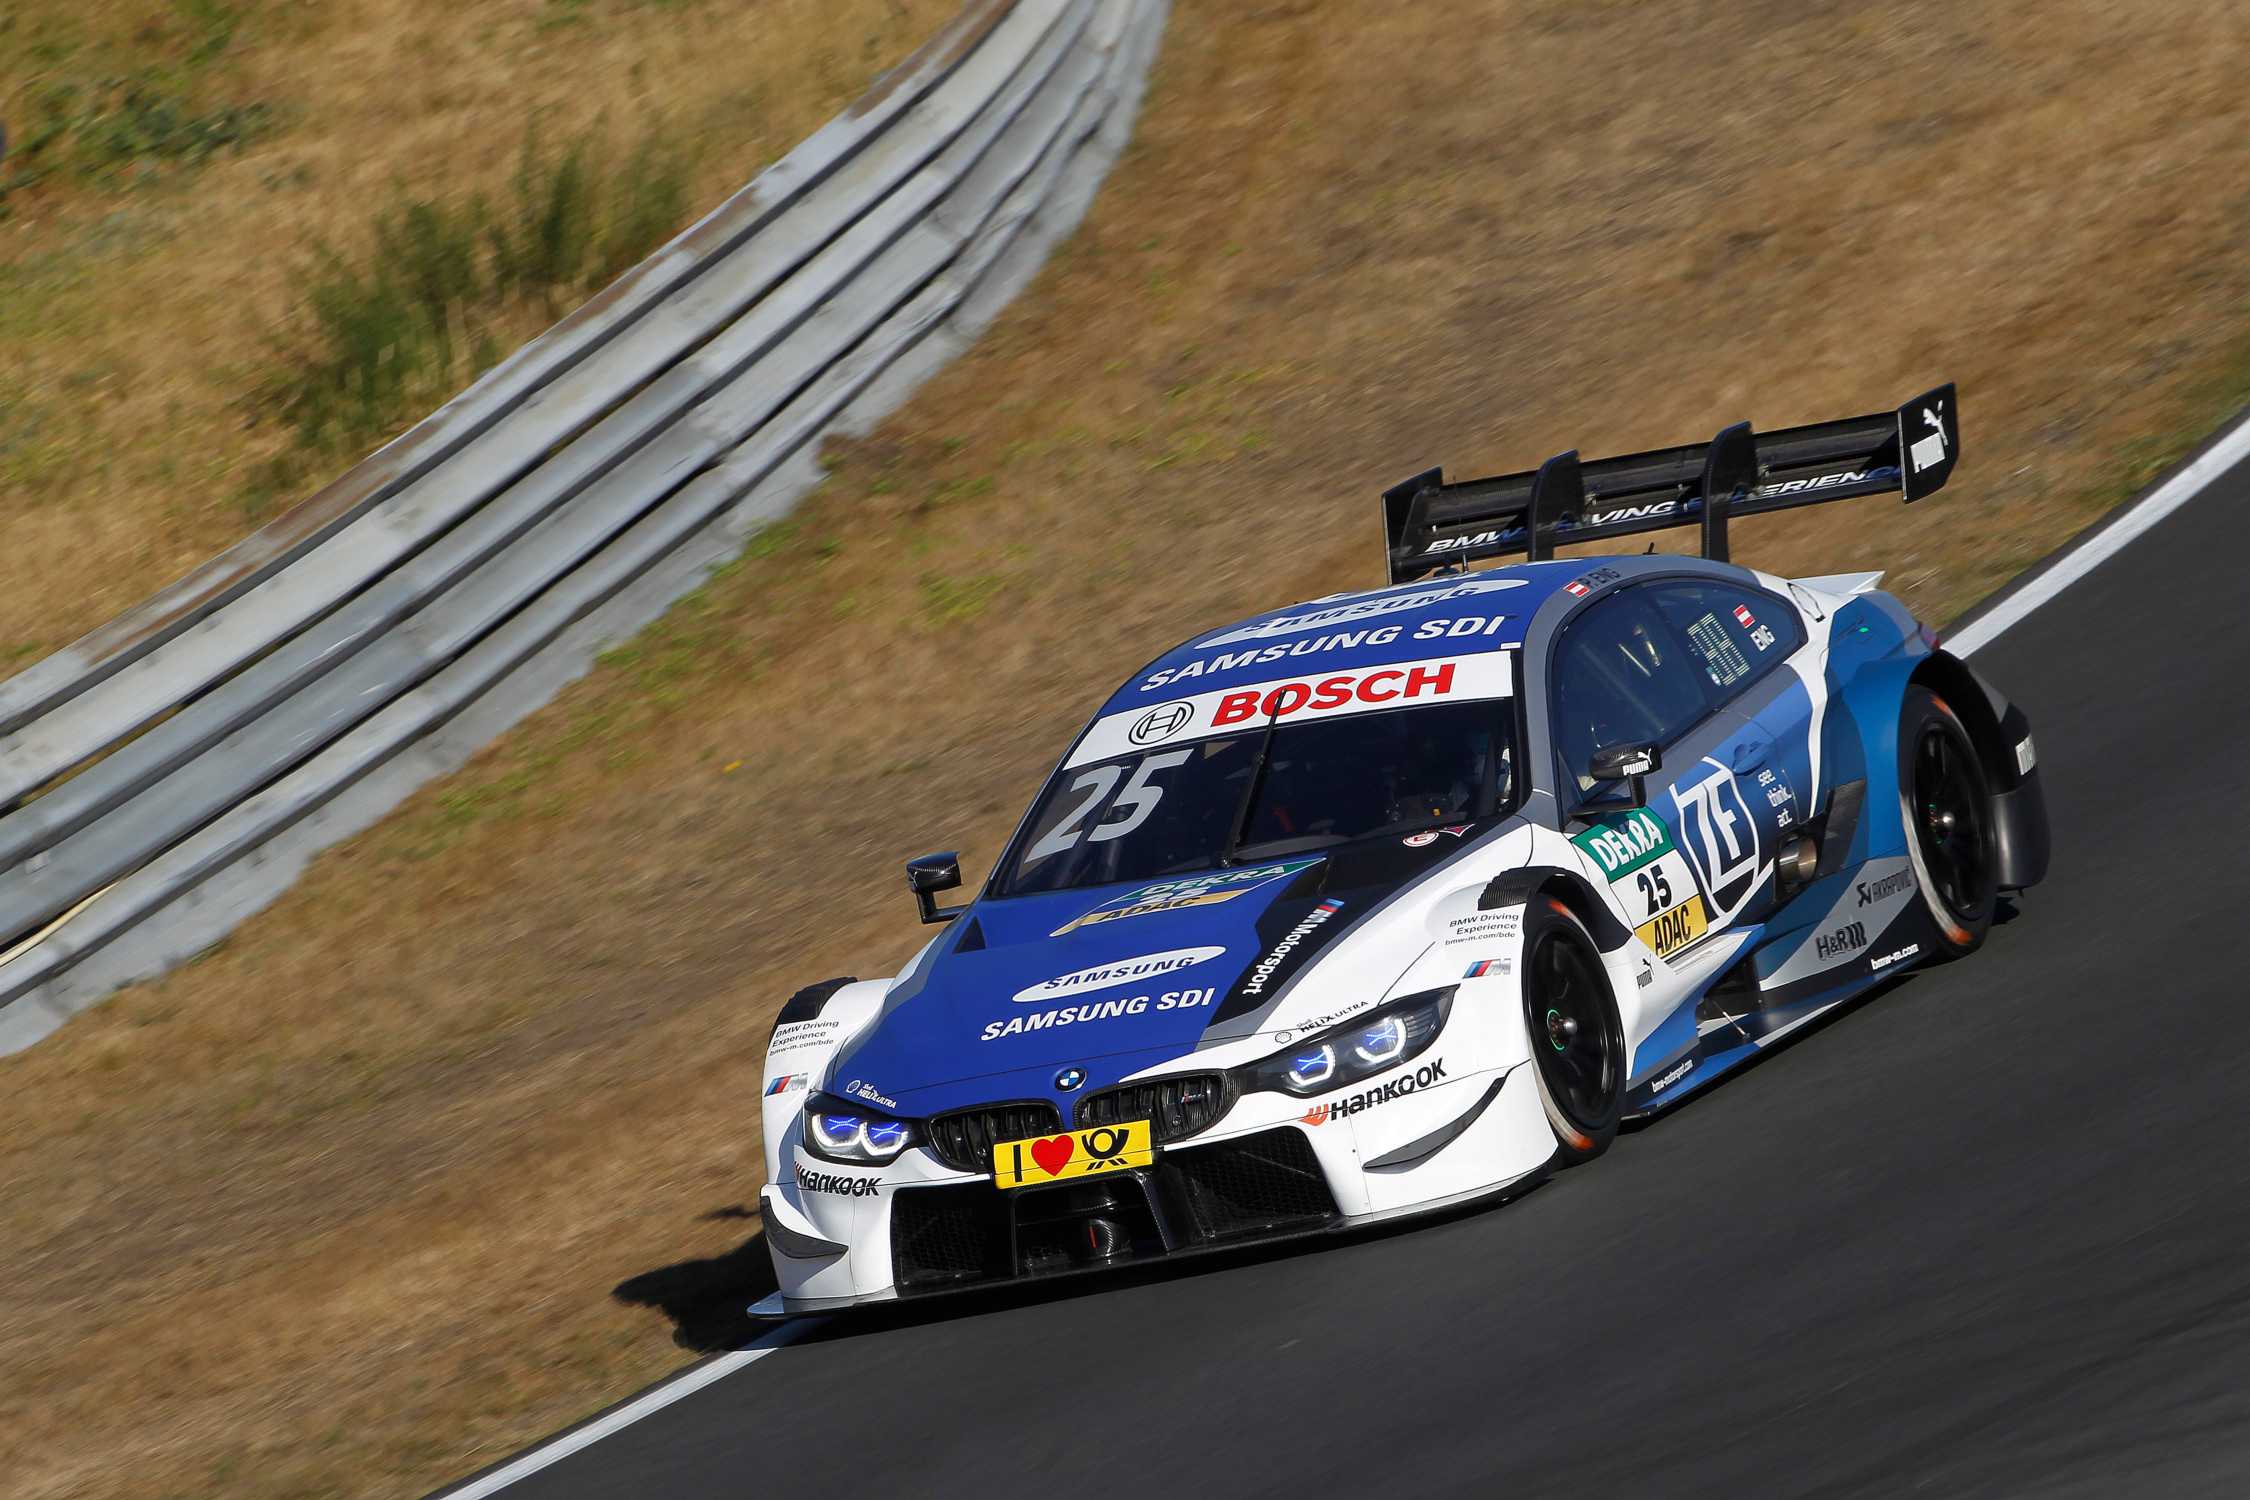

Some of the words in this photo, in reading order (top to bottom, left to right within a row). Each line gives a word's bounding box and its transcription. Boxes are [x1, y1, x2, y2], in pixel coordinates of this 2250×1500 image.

[1423, 528, 1524, 553] BMW
[1590, 500, 1677, 525] VING
[1244, 586, 1481, 633] SAMSUNG
[1140, 625, 1403, 692] SAMSUNG
[1413, 615, 1505, 640] SDI
[1210, 662, 1457, 727] BOSCH
[1023, 748, 1195, 864] 25
[1589, 812, 1664, 872] DEKRA
[1676, 768, 1762, 895] ZF
[1139, 865, 1285, 896] DEKRA
[1636, 864, 1673, 916] 25
[1099, 898, 1196, 922] ADAC
[1449, 915, 1478, 928] BMW
[1480, 912, 1519, 922] Driving
[1456, 923, 1518, 935] Experience
[1653, 904, 1692, 955] ADAC
[1242, 923, 1319, 995] Motorsport
[1816, 928, 1849, 959] H&R
[1044, 956, 1195, 990] SAMSUNG
[775, 1024, 801, 1038] BMW
[803, 1020, 840, 1030] Driving
[980, 995, 1150, 1041] SAMSUNG
[1156, 987, 1216, 1011] SDI
[1300, 1014, 1335, 1033] HELIX
[1334, 1000, 1369, 1017] ULTRA
[771, 1031, 827, 1048] Experience
[1013, 1144, 1023, 1183] I
